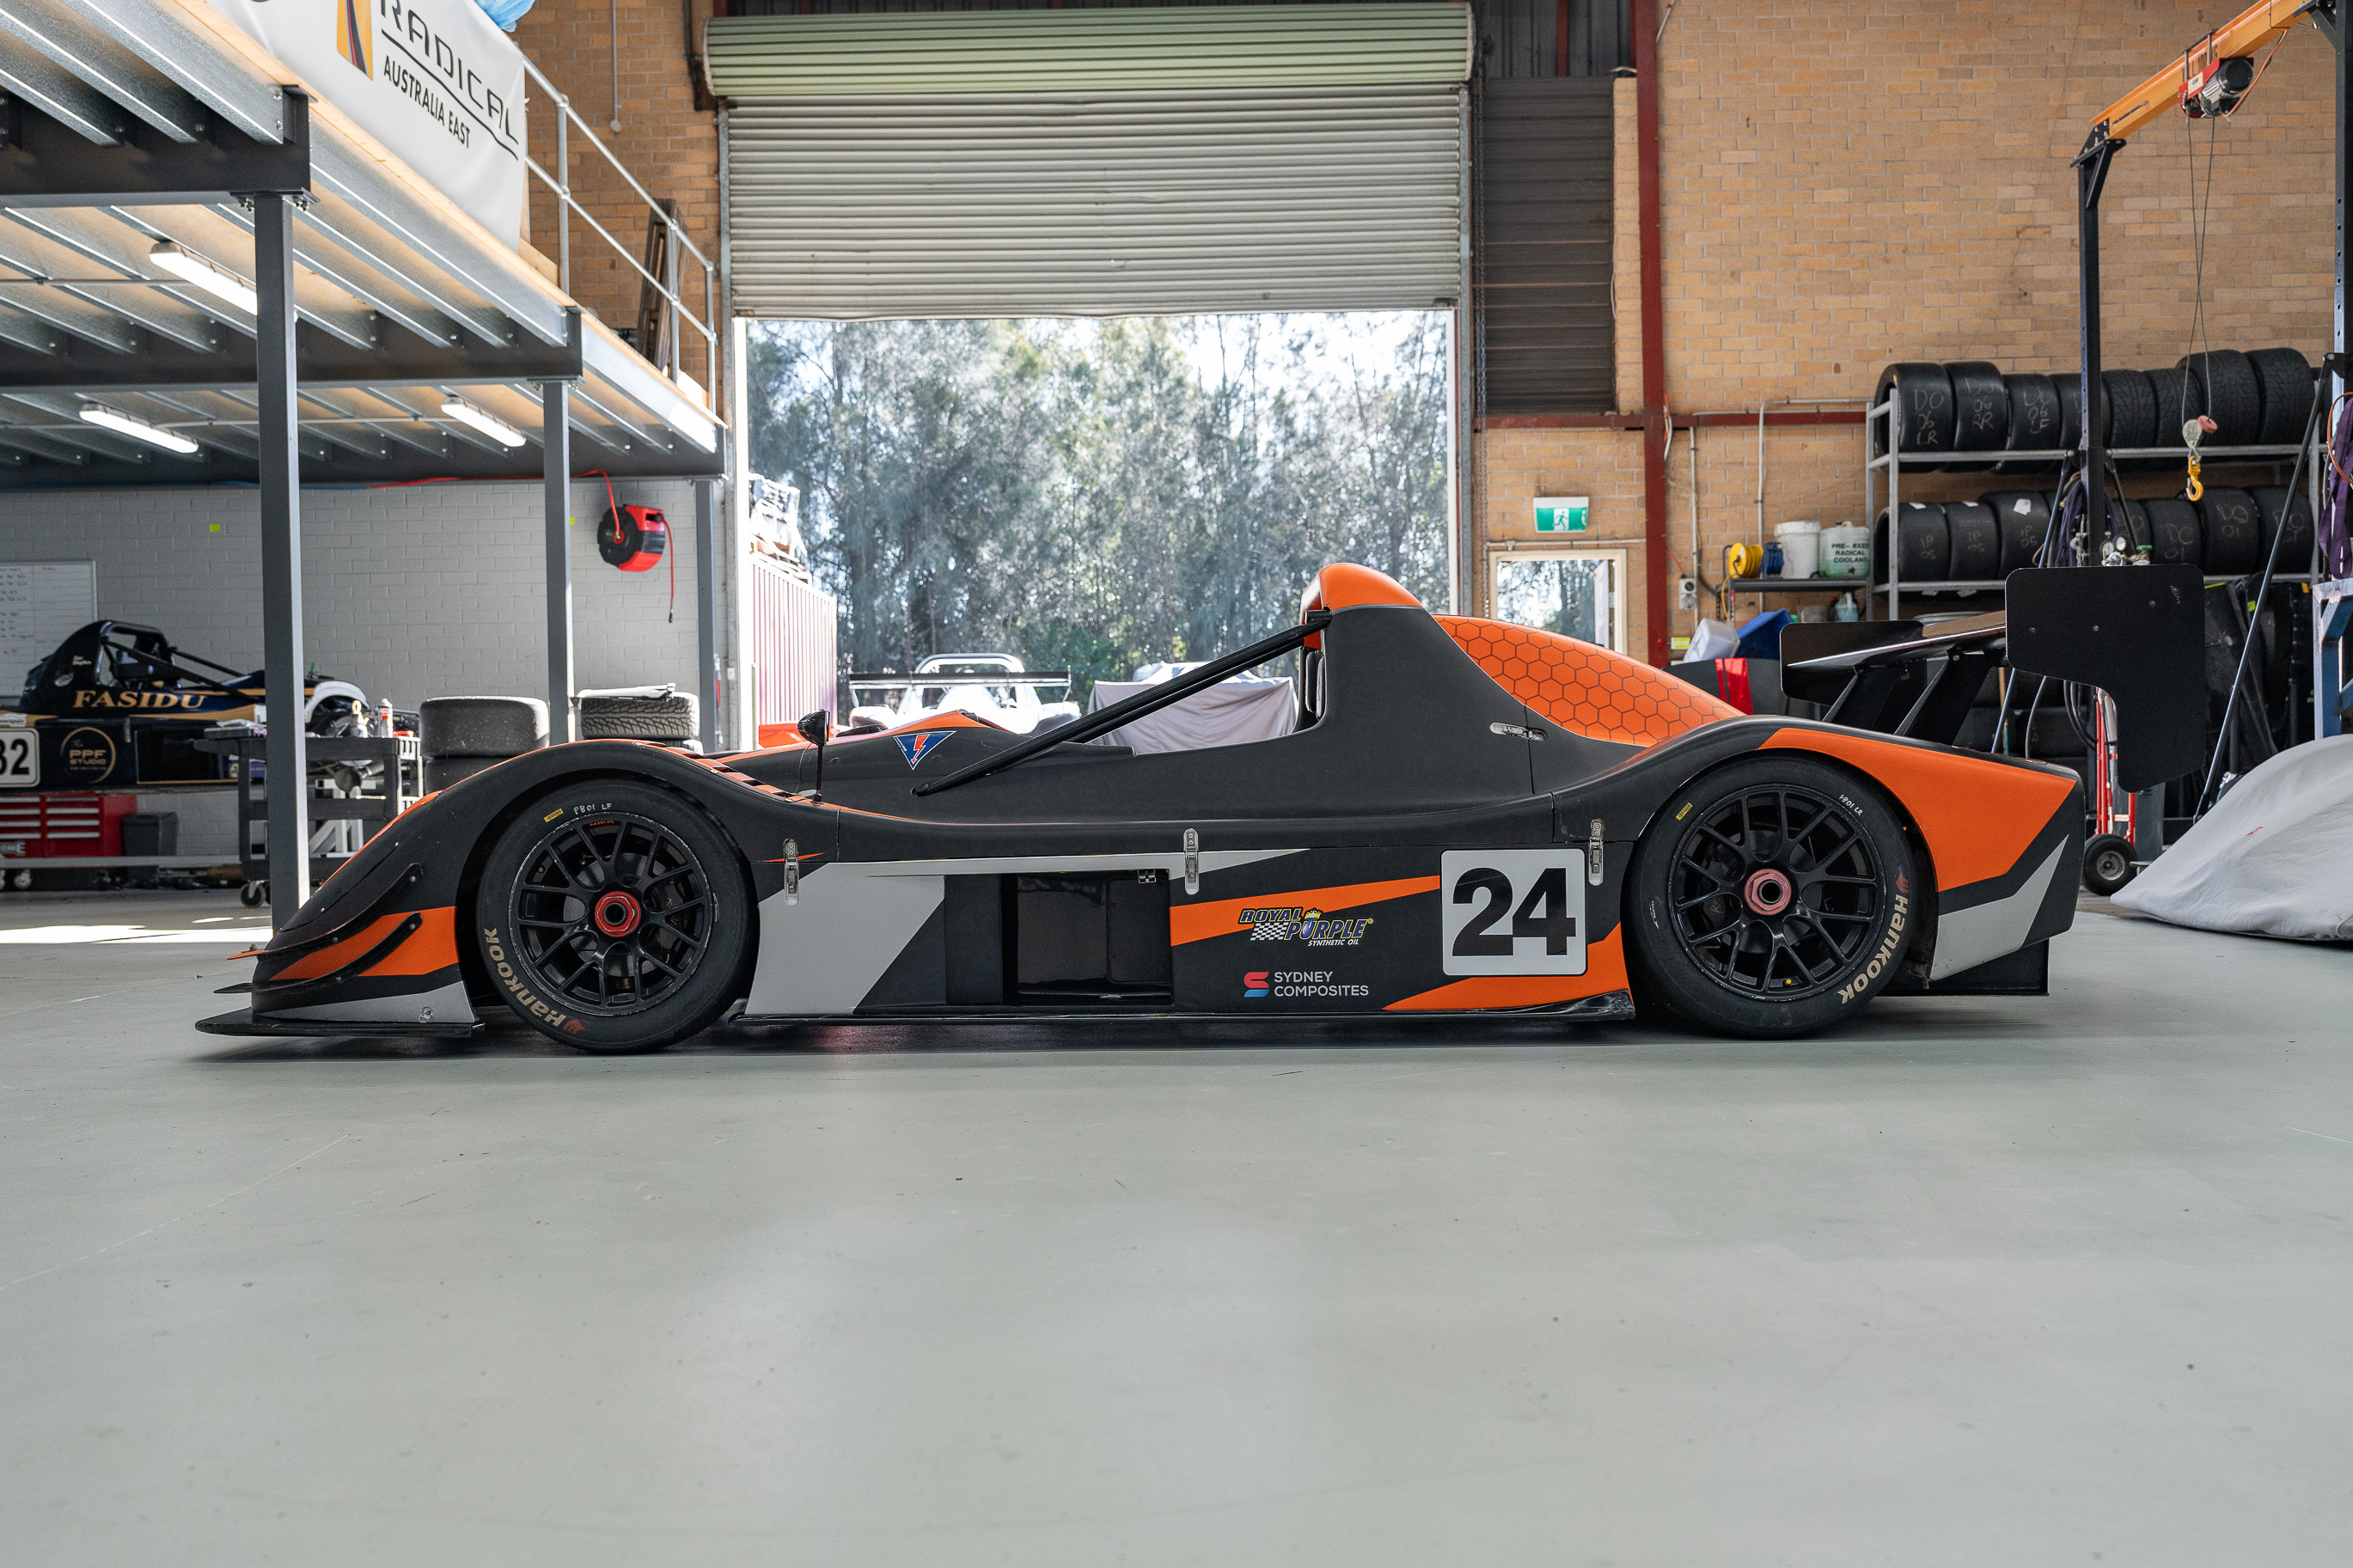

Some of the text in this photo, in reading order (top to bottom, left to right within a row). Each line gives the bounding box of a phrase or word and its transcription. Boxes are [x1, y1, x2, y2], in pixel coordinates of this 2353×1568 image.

[381, 0, 518, 145] RADICAL
[383, 55, 471, 149] AUSTRALIA EAST
[73, 690, 206, 710] FASIDU
[70, 749, 107, 759] PPF
[1239, 909, 1302, 923] ROYAL
[1452, 867, 1576, 956] 24
[1274, 971, 1333, 983] SYDNEY
[1274, 985, 1369, 997] COMPOSITES
